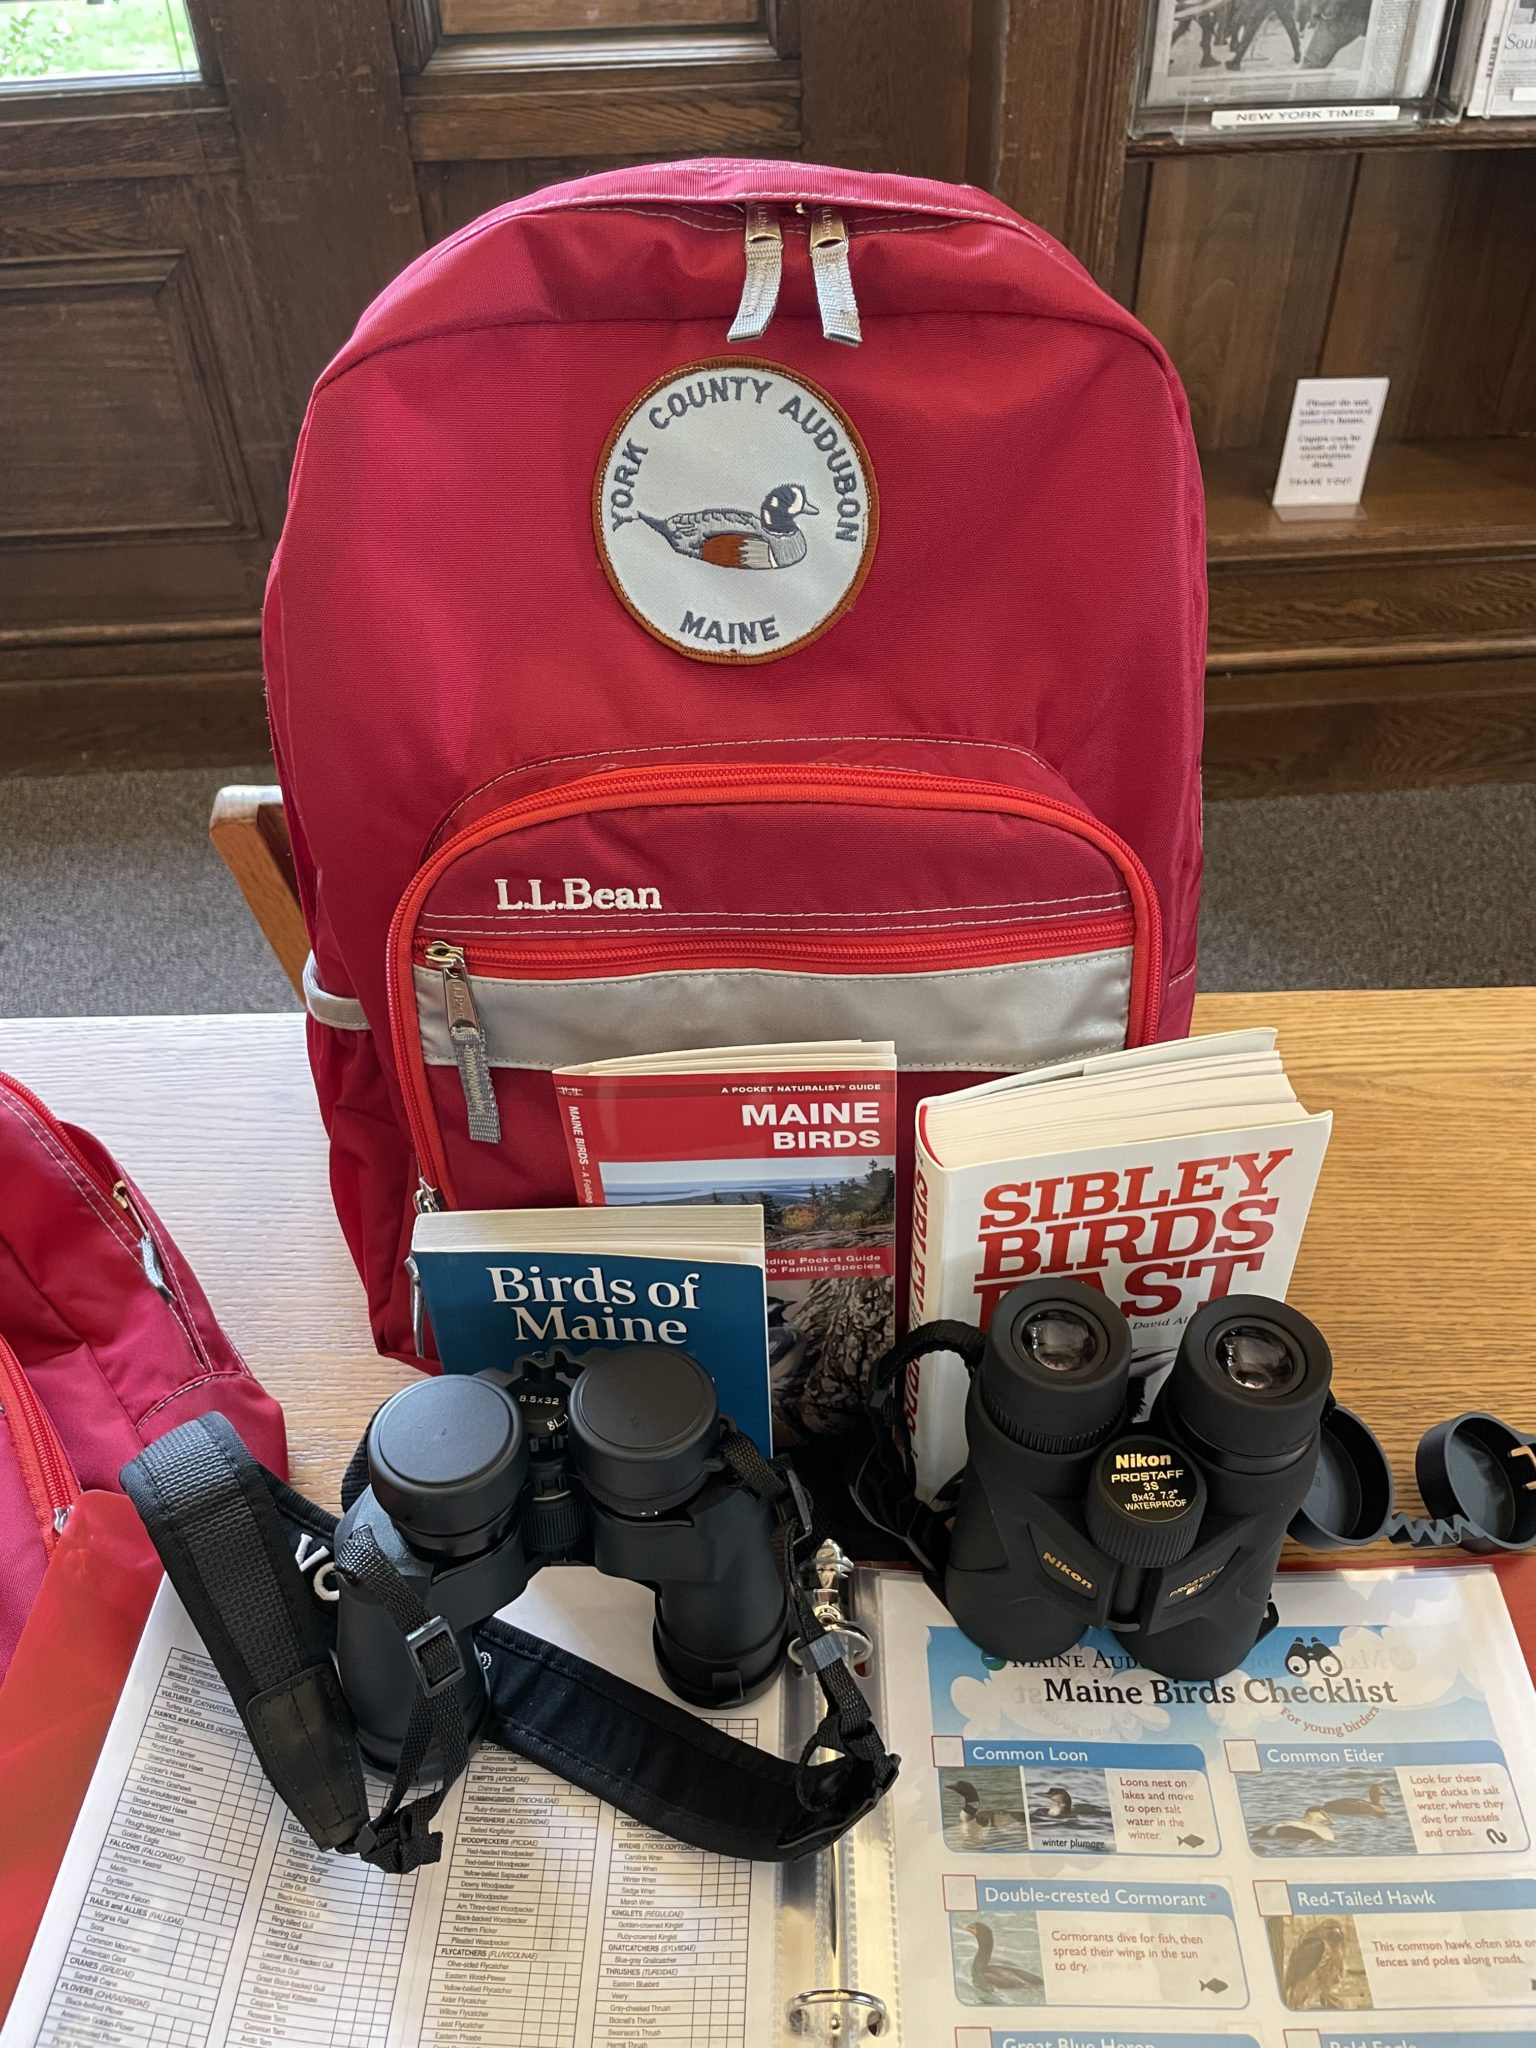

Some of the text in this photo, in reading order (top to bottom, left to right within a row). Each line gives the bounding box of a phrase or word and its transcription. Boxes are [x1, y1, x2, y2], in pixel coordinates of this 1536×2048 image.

[1504, 33, 1536, 49] Sou
[1235, 108, 1376, 122] NEW YORK TIMES
[610, 376, 861, 542] YORK COUNTY AUDUBON
[679, 610, 780, 644] MAINE
[494, 878, 662, 911] L.L.Bean
[849, 1083, 881, 1091] GUIDE
[568, 1105, 583, 1136] MAINE
[741, 1101, 880, 1127] MAINE
[773, 1130, 881, 1150] BIRDS
[575, 1137, 589, 1166] BIRDS
[979, 1148, 1293, 1230] SIBLEY
[974, 1197, 1279, 1282] BIRDS
[765, 1254, 881, 1266] lding Pocket Guide
[781, 1265, 830, 1273] Familiar
[833, 1263, 881, 1272] Species
[485, 1265, 701, 1310] Birds of
[973, 1252, 1264, 1332] ST
[511, 1306, 688, 1345] Maine
[1132, 1316, 1189, 1330] David Al
[1115, 1453, 1172, 1469] Nikon
[1111, 1469, 1184, 1483] PROSTAFF
[1143, 1482, 1159, 1491] 3S
[1131, 1491, 1155, 1502] 8x42
[1124, 1499, 1187, 1511] WATERPROOF
[1042, 1551, 1093, 1590] Nikon
[1093, 1649, 1139, 1669] AUD
[1043, 1678, 1398, 1705] Maine Birds Checklist
[1280, 1706, 1380, 1737] For young birders
[972, 1746, 1088, 1762] Common Loon
[1267, 1749, 1384, 1763] Common Eider
[1120, 1777, 1187, 1788] Loons nest on
[1410, 1774, 1482, 1785] Look for these
[1122, 1790, 1194, 1801] lakes and move
[1413, 1786, 1500, 1800] large ducks in salt
[1124, 1804, 1182, 1815] to open salt
[1417, 1799, 1504, 1811] water, where they
[465, 1816, 505, 1824] KINGFISHERS
[1126, 1818, 1185, 1827] water in the
[1421, 1812, 1500, 1824] dive for mussels
[1128, 1830, 1162, 1840] winter.
[1425, 1828, 1443, 1837] and
[109, 1838, 140, 1853] FALCONS
[461, 1837, 509, 1846] WOODPECKERS
[1041, 1838, 1106, 1850] winter plumage
[984, 1887, 1208, 1907] Double-crested Cormorant
[1297, 1890, 1436, 1908] Red-Tailed Hawk
[1051, 1930, 1204, 1945] Cormorants dive for fish, then
[608, 1944, 659, 1952] GNATCATCHERS
[1371, 1941, 1395, 1952] This
[1397, 1942, 1443, 1952] common
[1444, 1940, 1472, 1950] hawk
[1475, 1938, 1502, 1949] often
[1505, 1938, 1521, 1948] sits
[441, 1948, 487, 1957] FLYCATCHERS
[1053, 1946, 1199, 1960] spread their wings in the sun
[69, 1957, 99, 1970] CRANES
[1055, 1961, 1089, 1974] to dry.
[1375, 1957, 1408, 1967] fences
[1411, 1956, 1429, 1966] and
[1433, 1955, 1460, 1968] poles
[1463, 1954, 1491, 1968] along
[606, 1968, 641, 1976] THRUSHES
